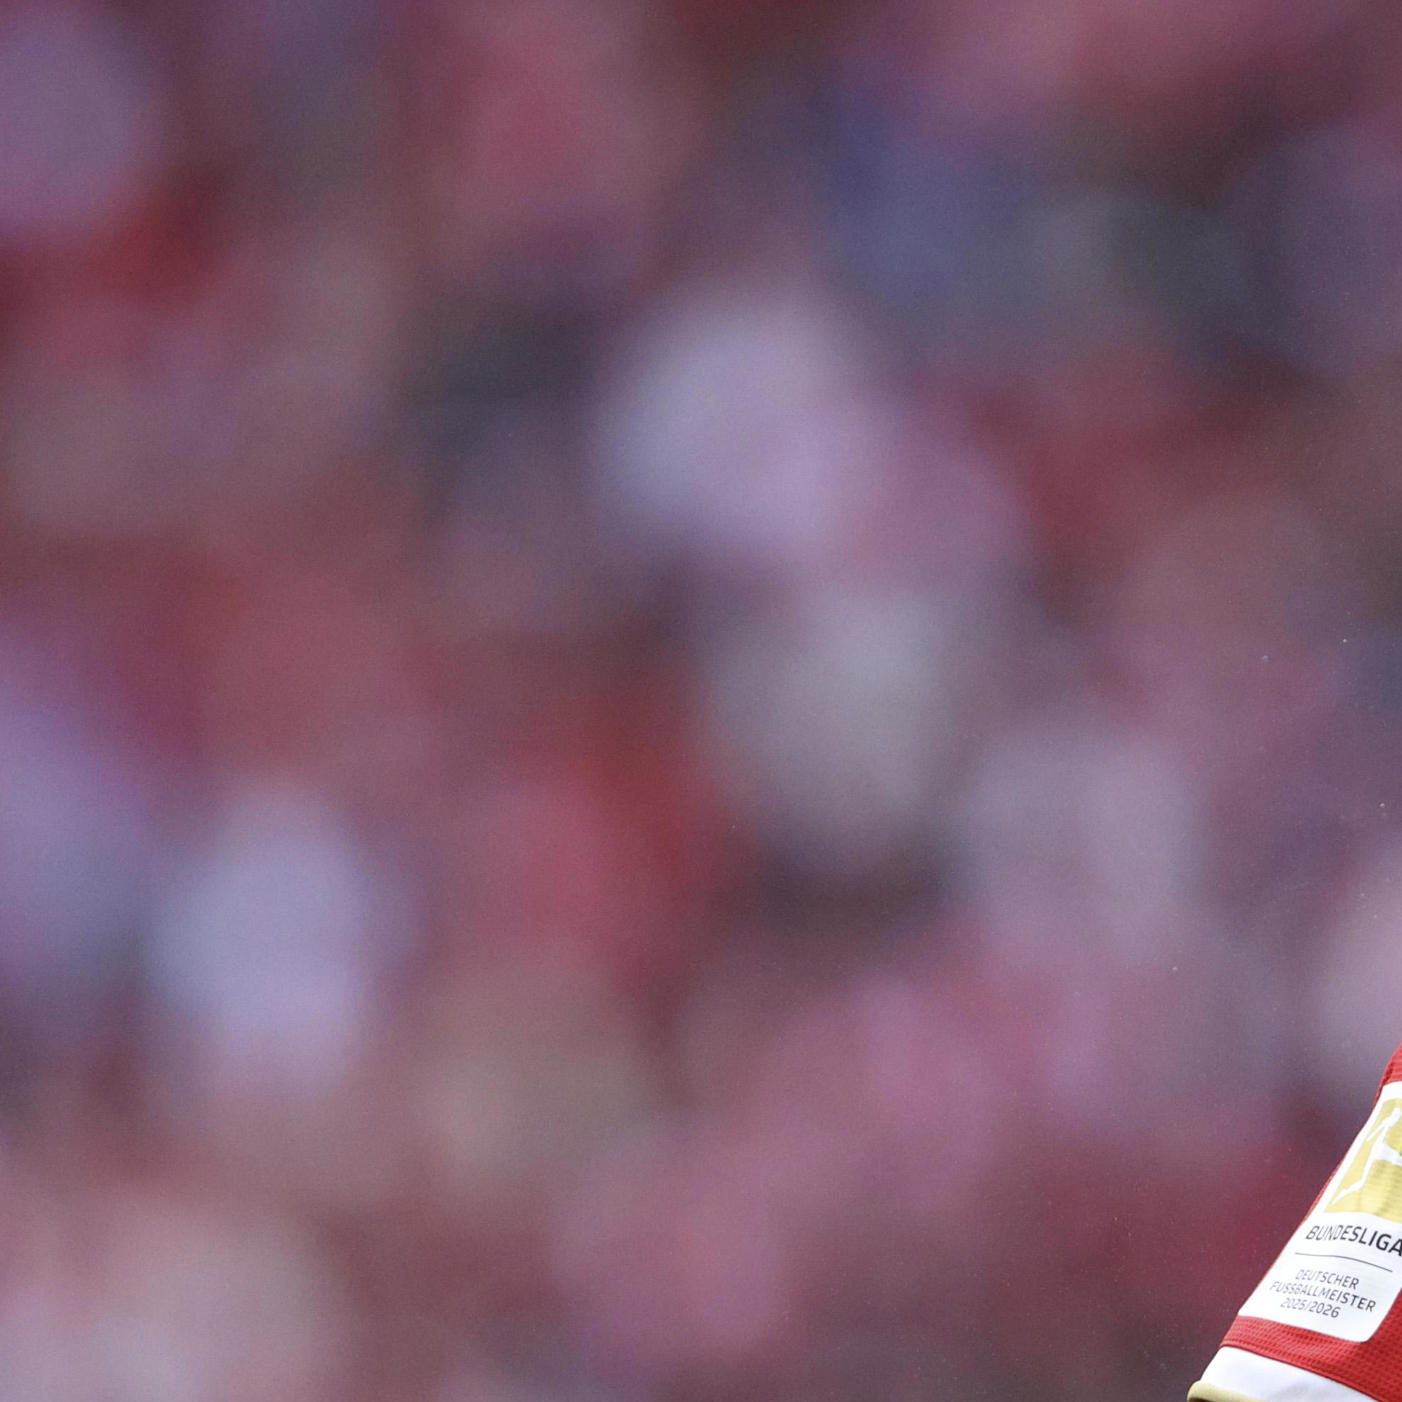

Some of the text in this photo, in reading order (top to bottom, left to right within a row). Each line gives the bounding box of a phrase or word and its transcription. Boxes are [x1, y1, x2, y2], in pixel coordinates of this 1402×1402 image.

[1295, 1269, 1360, 1290] DEUTSCHER
[1270, 1281, 1376, 1312] FUSSBALLMEISTER
[1280, 1297, 1341, 1318] 2025/2026
